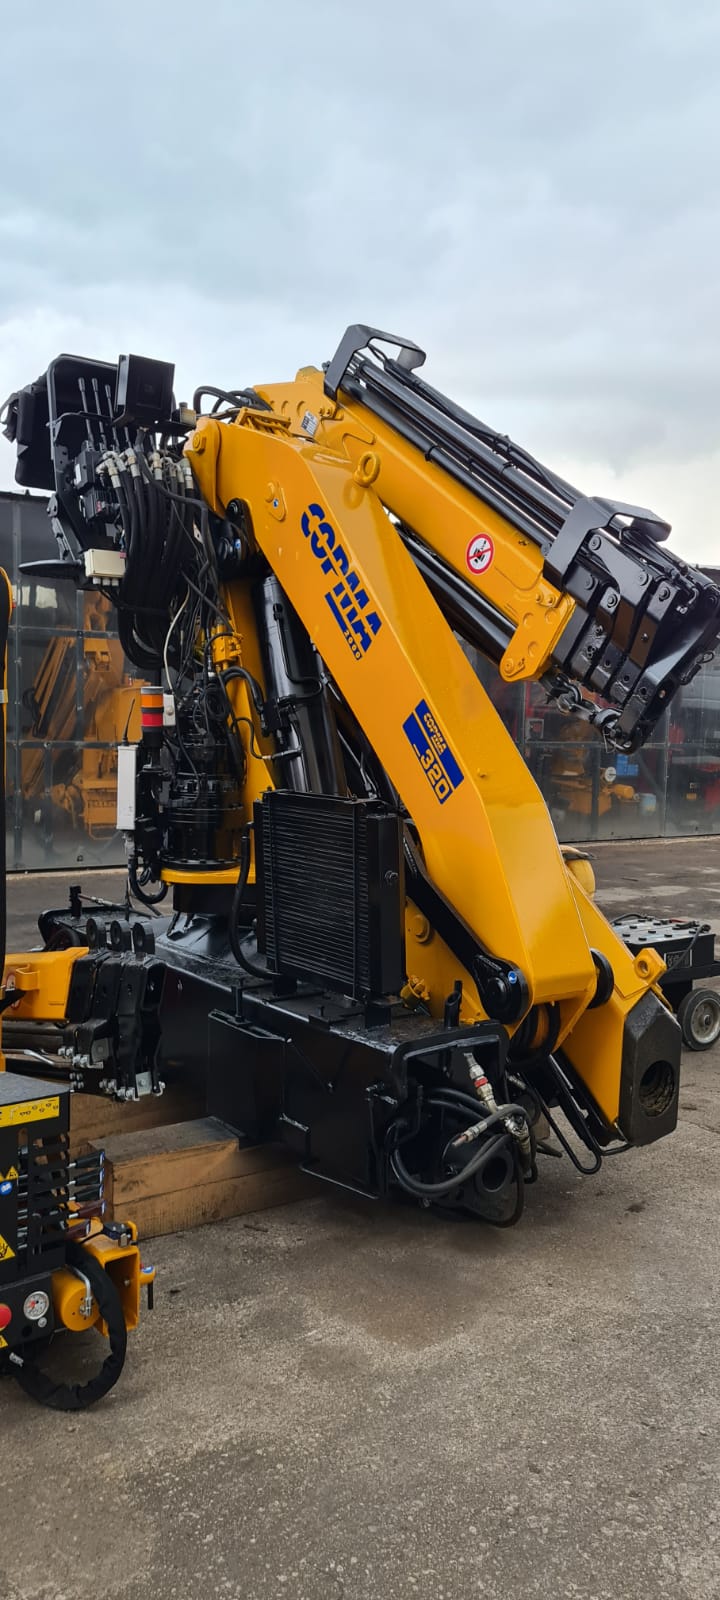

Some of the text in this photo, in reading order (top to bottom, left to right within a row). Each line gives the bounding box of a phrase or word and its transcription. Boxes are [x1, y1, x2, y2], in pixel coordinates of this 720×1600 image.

[301, 503, 382, 652] COPMA
[344, 630, 361, 660] 2000
[423, 713, 447, 752] COPMA
[420, 748, 450, 801] 320
